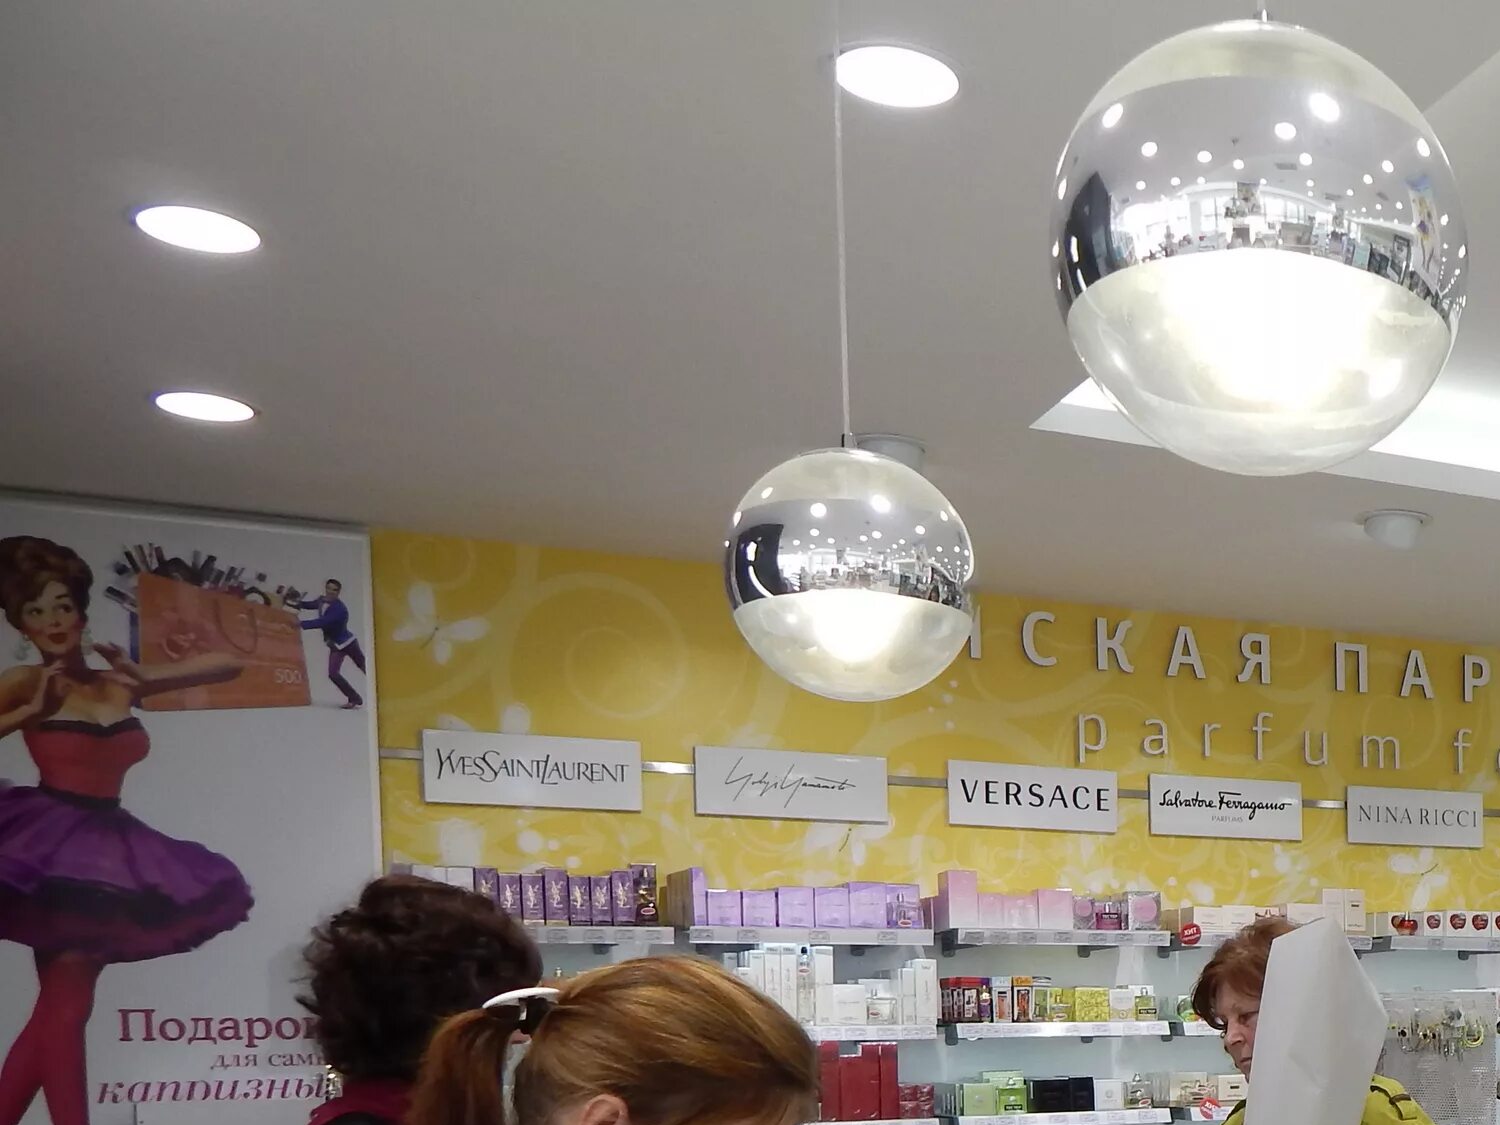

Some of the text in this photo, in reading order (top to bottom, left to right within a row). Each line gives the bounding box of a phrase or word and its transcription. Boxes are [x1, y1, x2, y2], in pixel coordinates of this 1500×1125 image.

[1077, 711, 1400, 770] parfum
[960, 778, 1111, 813] VERSACE
[1158, 790, 1292, 821] Salvatore Ferragamo
[210, 1052, 258, 1070] для
